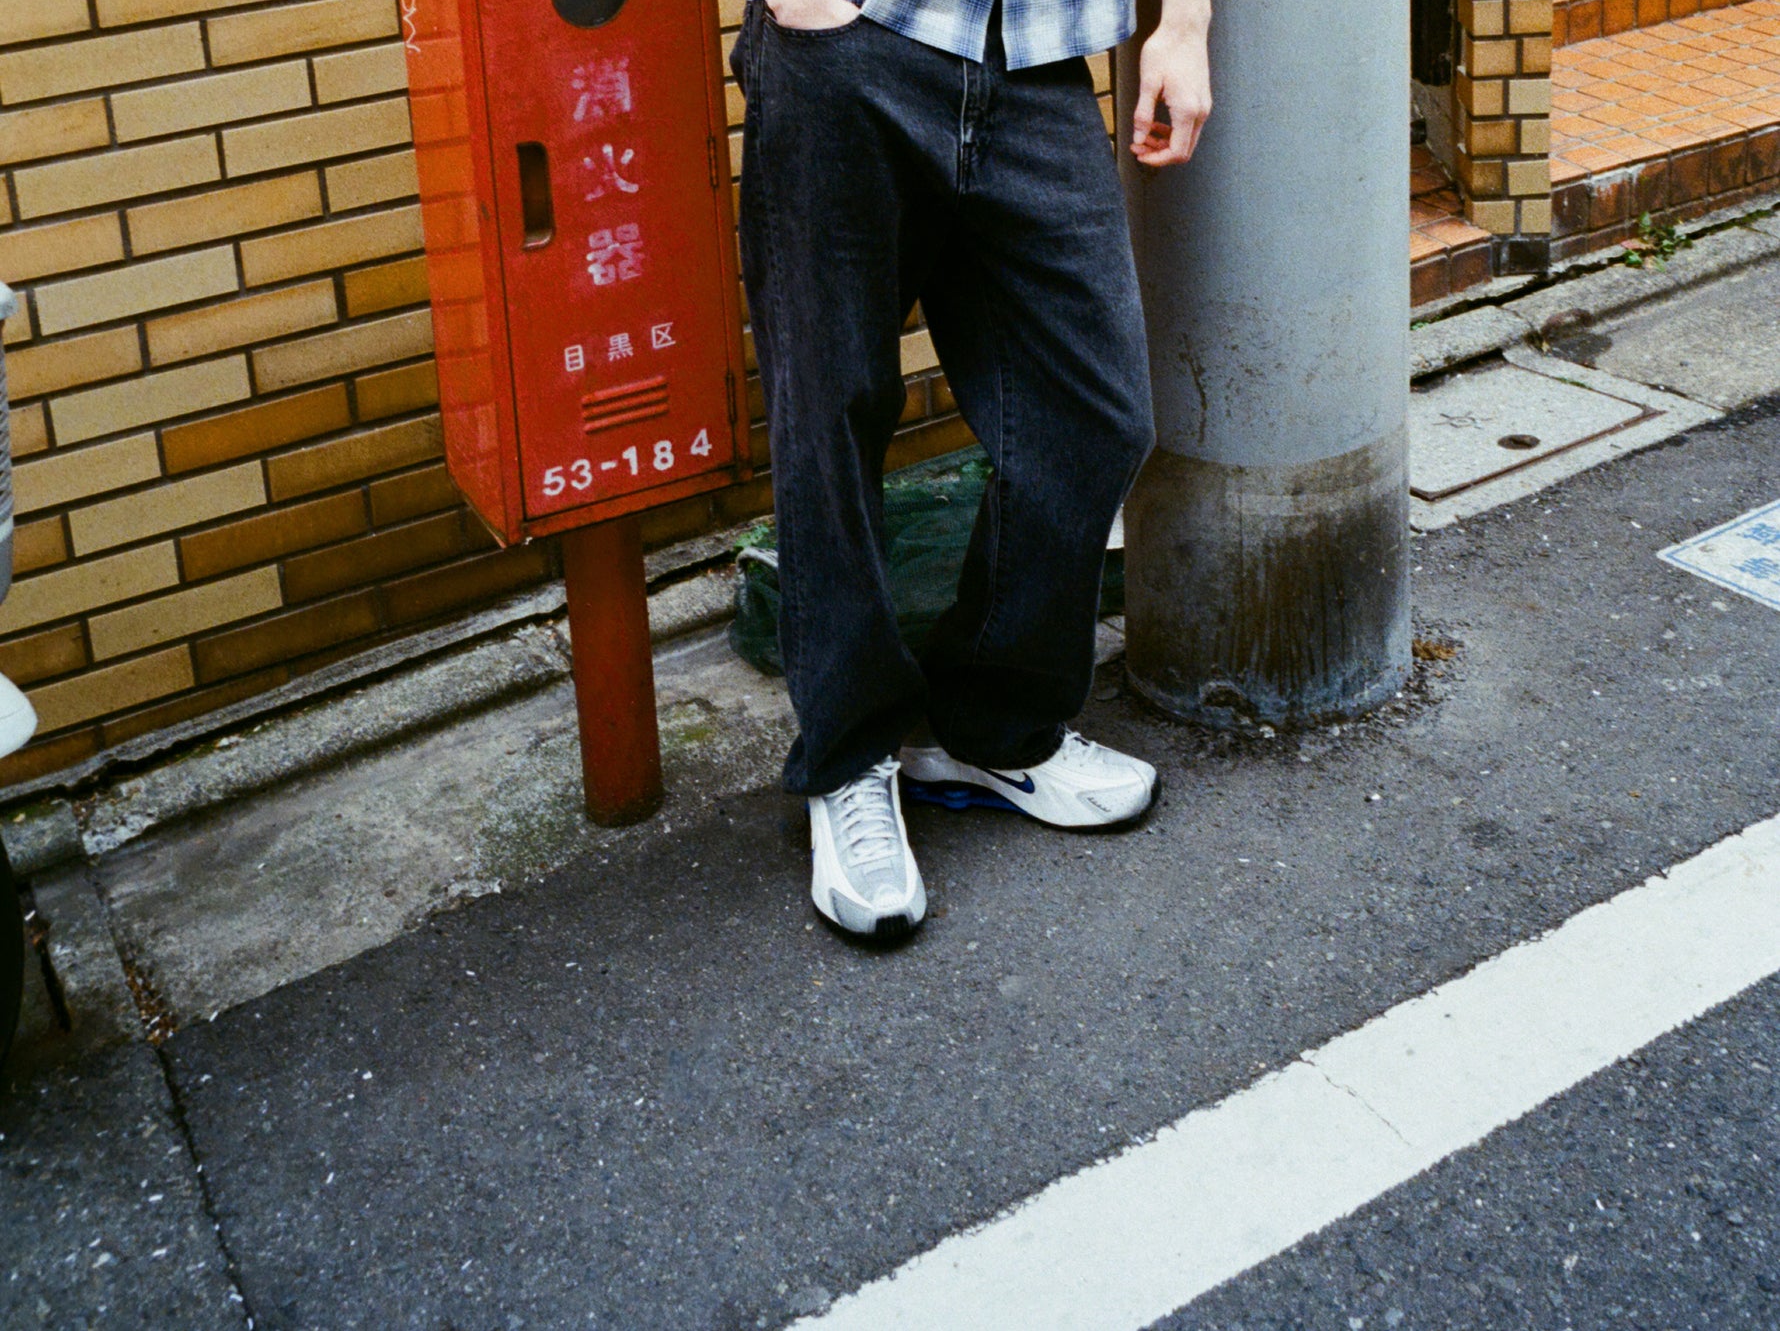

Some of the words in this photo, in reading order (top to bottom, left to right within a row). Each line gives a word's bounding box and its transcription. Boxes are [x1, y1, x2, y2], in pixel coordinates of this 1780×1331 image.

[565, 321, 676, 372] 目黒区
[543, 428, 712, 496] 53-184
